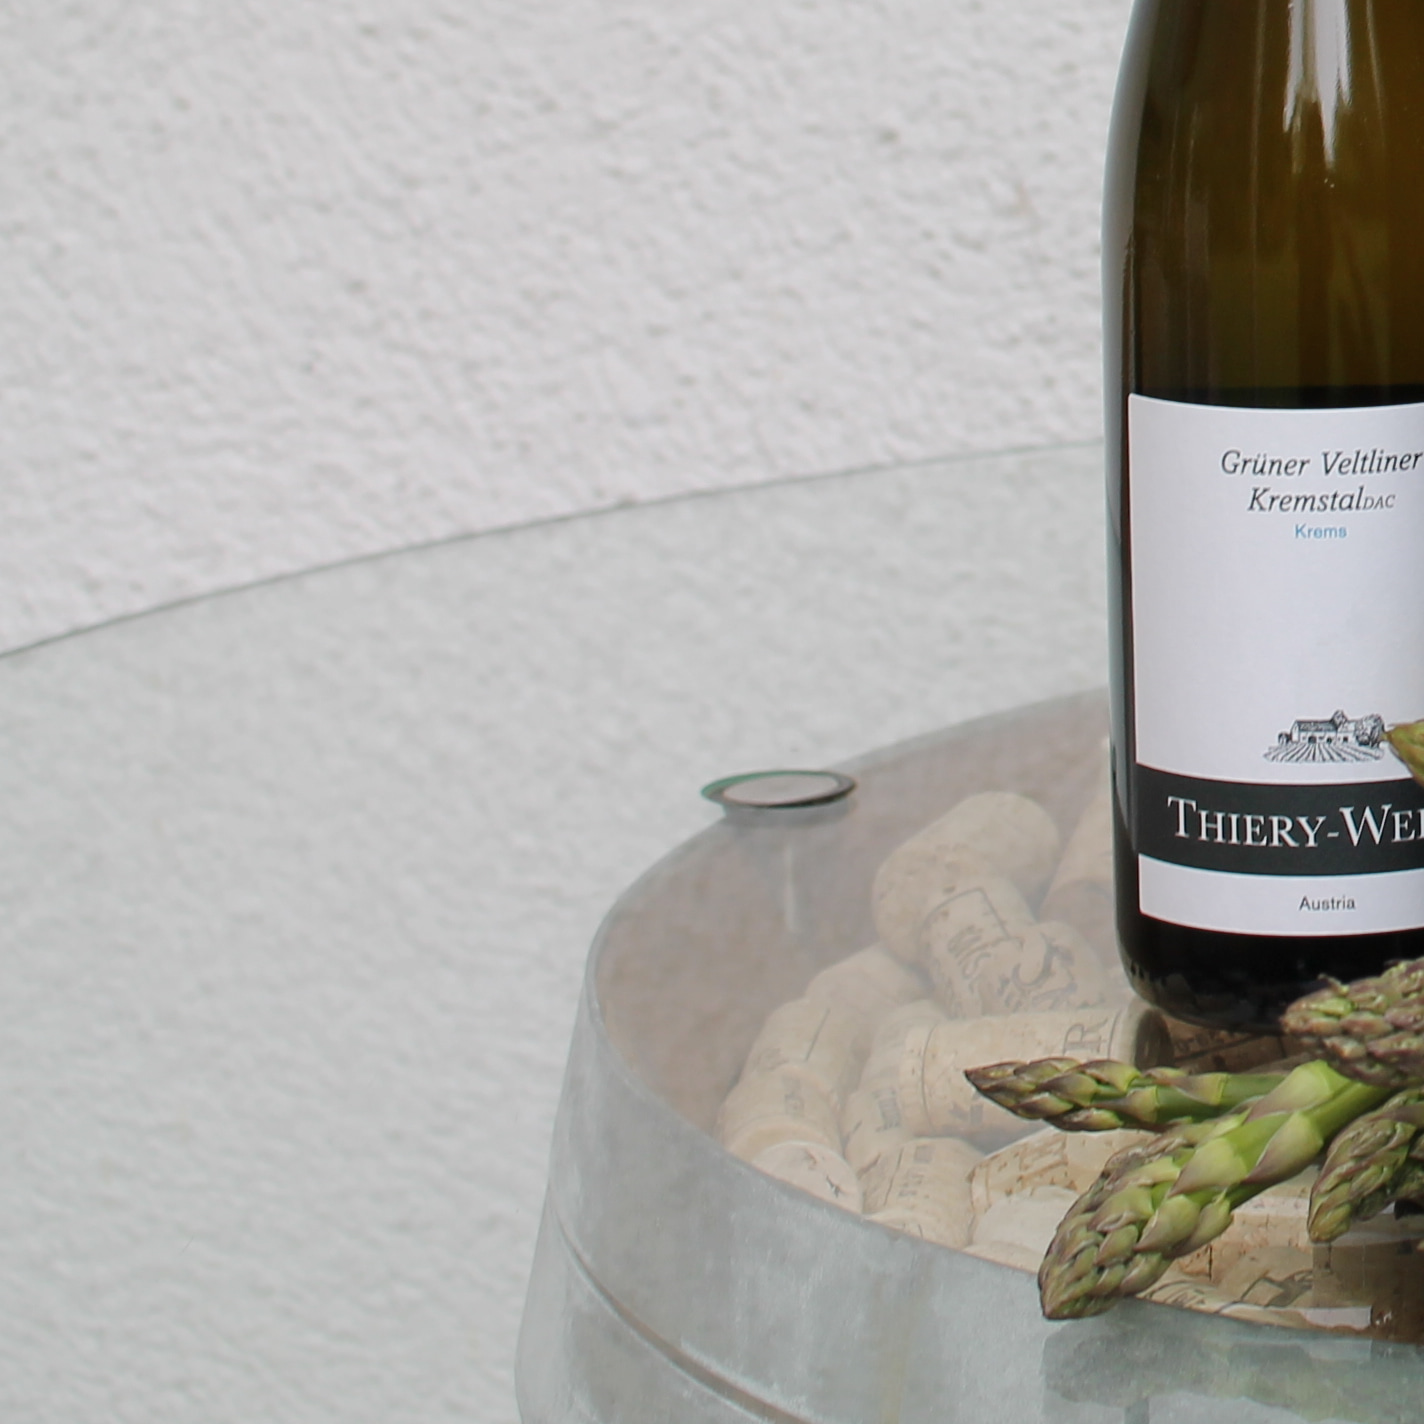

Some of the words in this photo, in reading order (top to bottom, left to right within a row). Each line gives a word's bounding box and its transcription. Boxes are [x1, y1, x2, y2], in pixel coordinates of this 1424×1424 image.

[1221, 448, 1310, 476] Grüner
[1321, 448, 1423, 475] Veltliner
[1294, 523, 1347, 539] Krems
[1299, 895, 1356, 912] Austria
